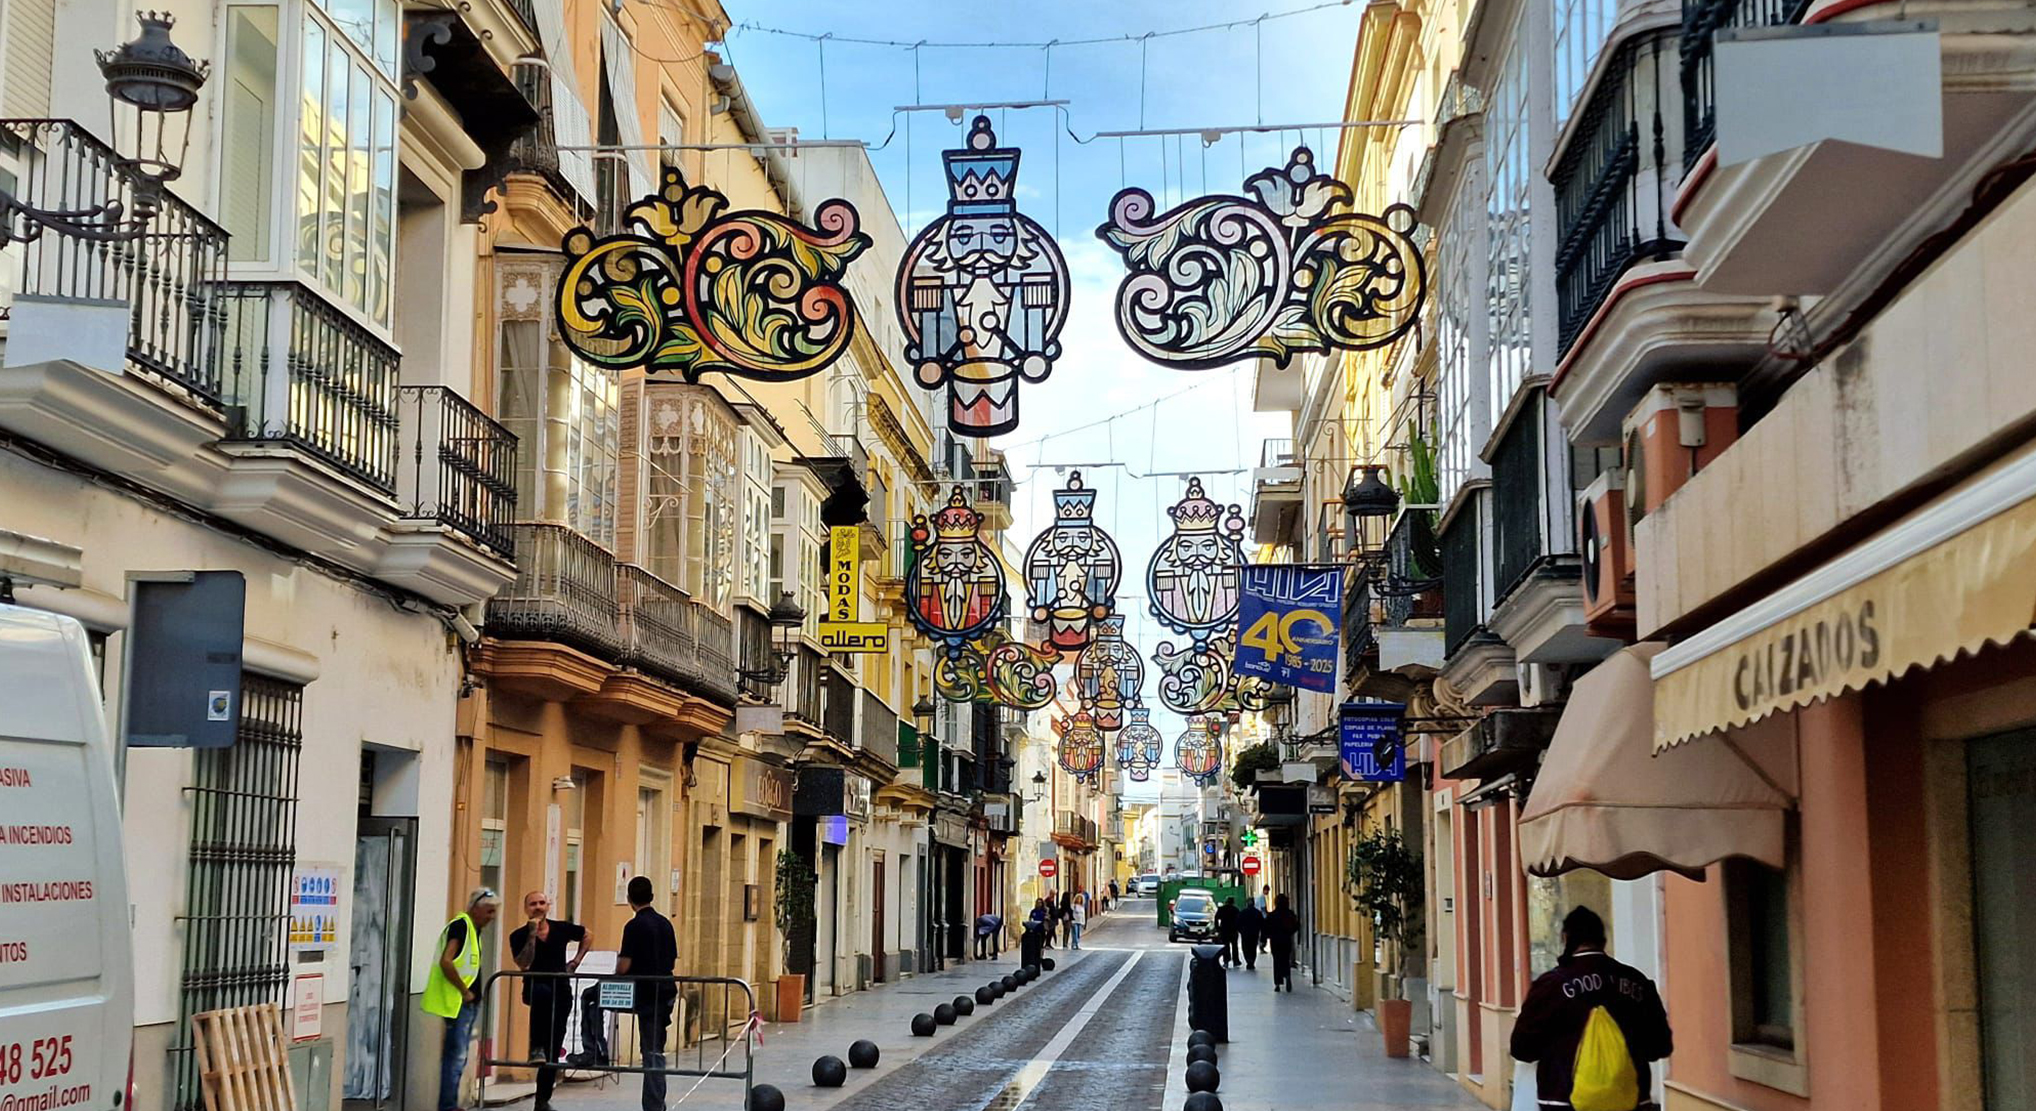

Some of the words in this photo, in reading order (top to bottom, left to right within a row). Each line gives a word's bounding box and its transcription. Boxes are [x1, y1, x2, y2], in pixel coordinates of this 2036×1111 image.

[837, 560, 851, 620] MODAS
[1241, 609, 1335, 662] 40
[1309, 658, 1334, 674] 2025
[8, 825, 72, 845] INCENDIOS
[2, 881, 93, 903] INSTALACIONES
[0, 941, 27, 963] TOS
[31, 1035, 72, 1080] 525
